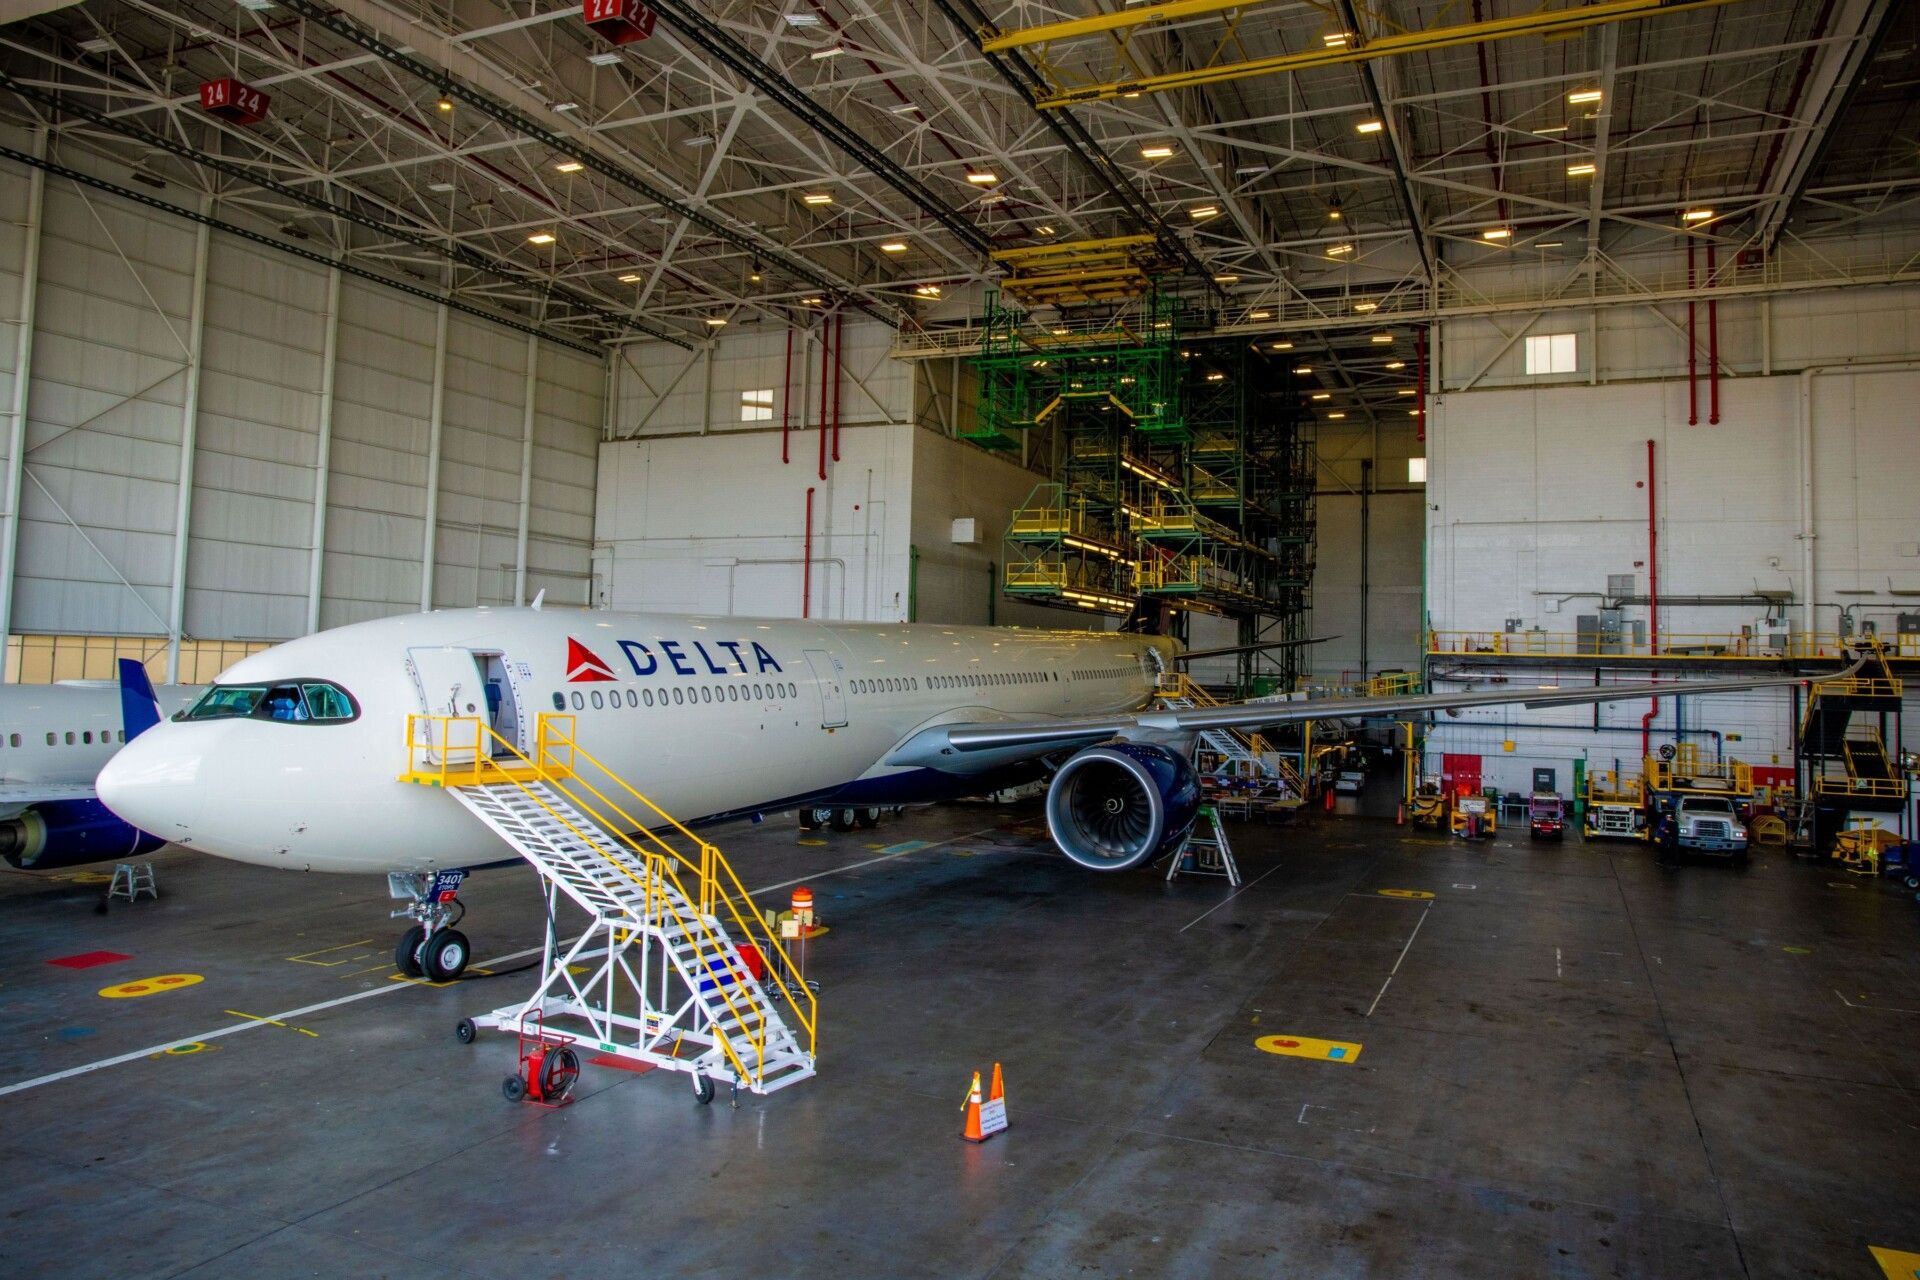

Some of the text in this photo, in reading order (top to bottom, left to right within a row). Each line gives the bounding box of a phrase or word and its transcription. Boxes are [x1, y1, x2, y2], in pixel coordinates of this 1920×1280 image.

[592, 0, 614, 18] 22
[628, 0, 649, 29] 22
[208, 83, 224, 106] 24
[237, 87, 260, 113] 24
[616, 640, 783, 676] DELTA
[437, 874, 463, 885] 3401
